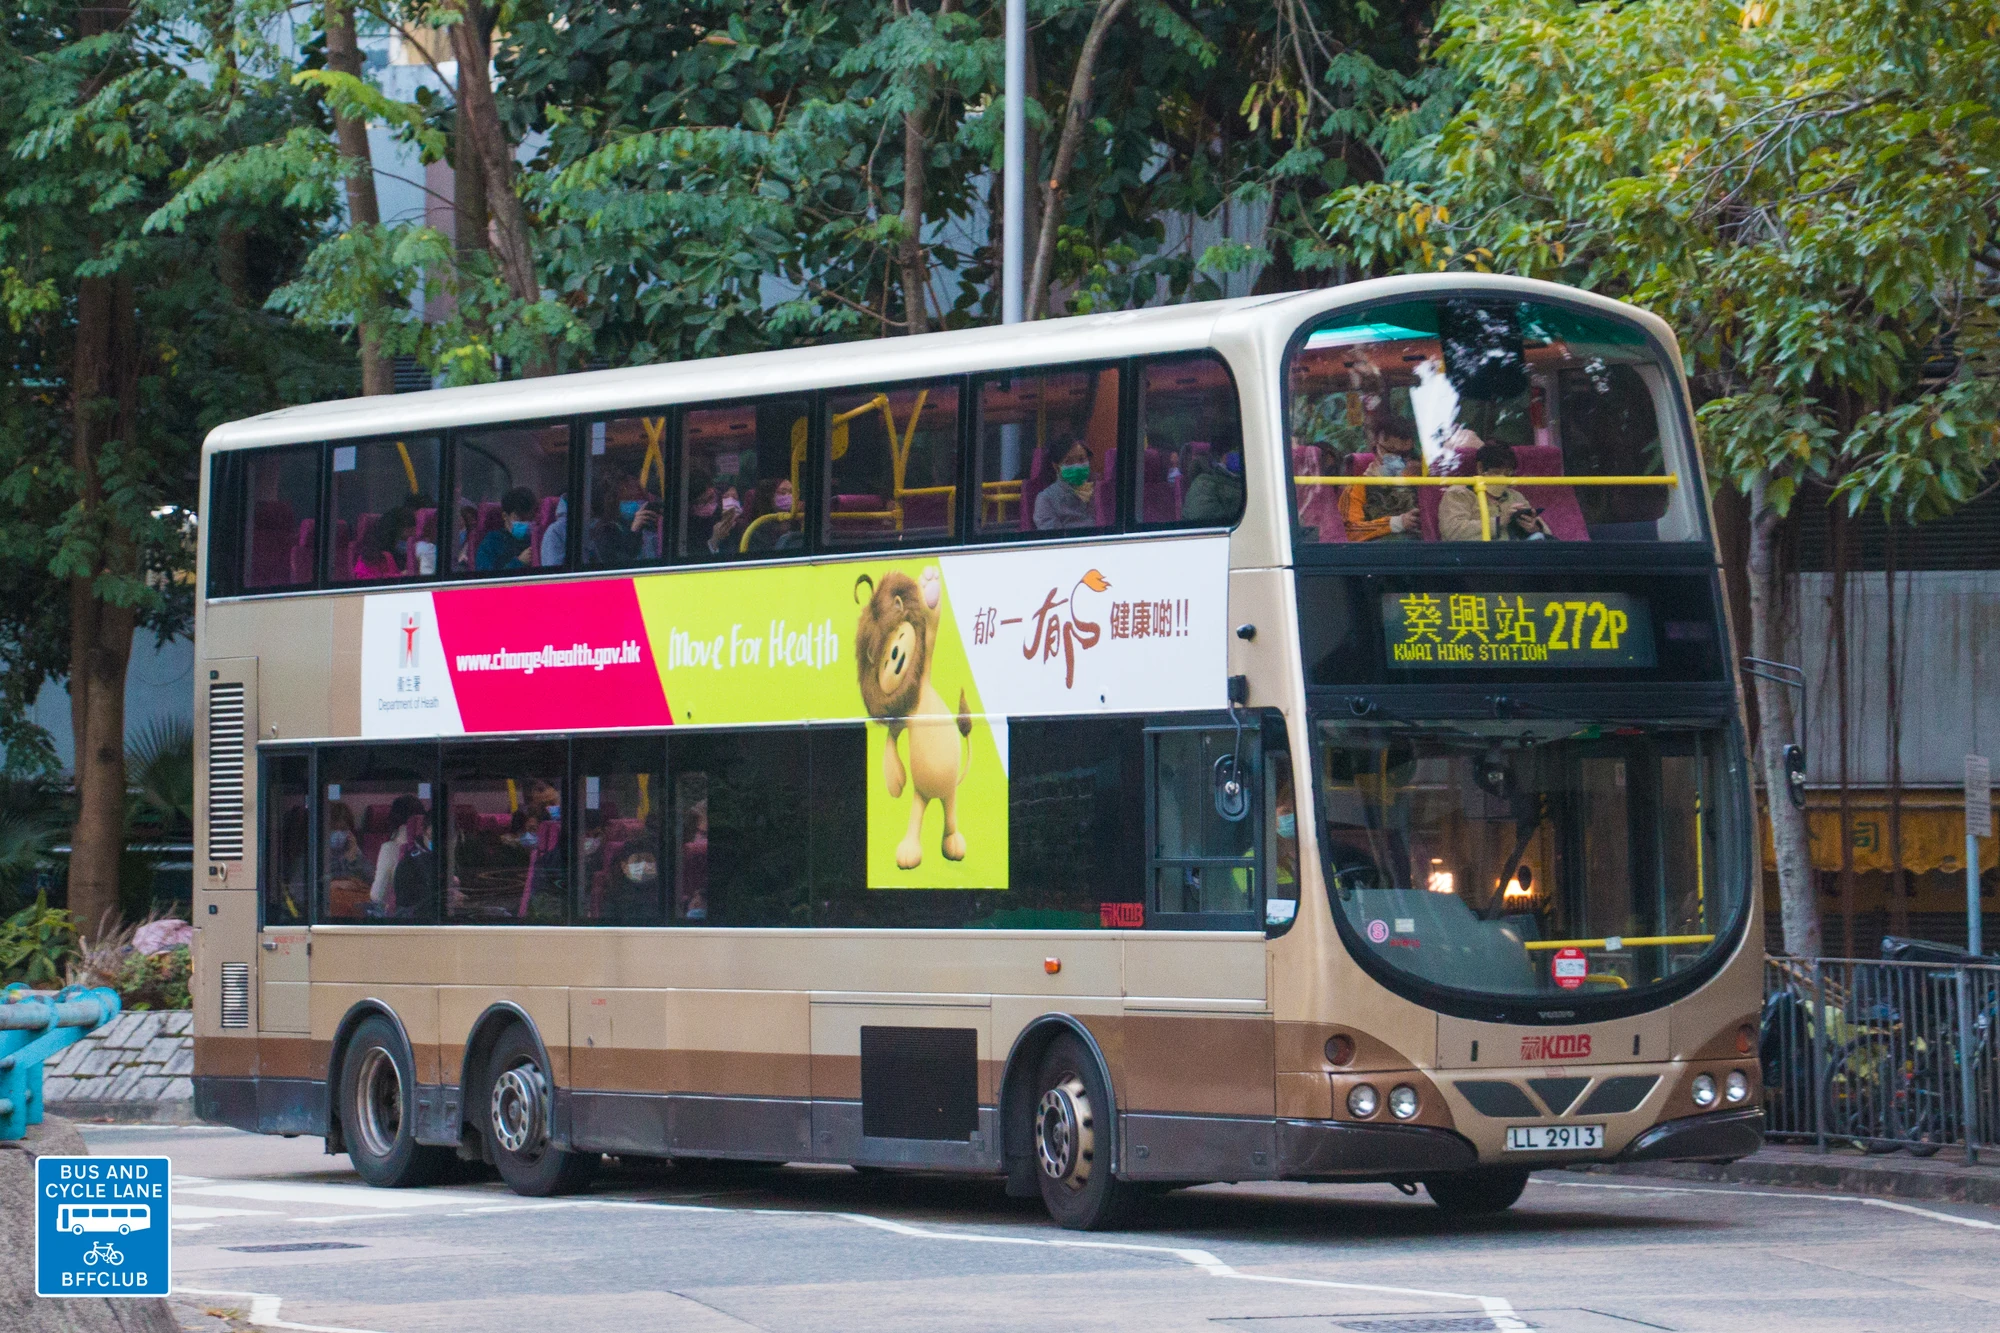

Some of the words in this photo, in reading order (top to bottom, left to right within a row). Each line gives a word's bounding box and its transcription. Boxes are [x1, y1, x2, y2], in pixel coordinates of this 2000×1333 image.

[1399, 593, 1537, 643] 葵興站
[1544, 601, 1628, 650] 272P
[456, 640, 641, 674] www.change4health.gov.hk
[668, 626, 725, 670] Move
[729, 623, 763, 668] For
[768, 618, 839, 671] Health
[1393, 643, 1433, 661] KWAI
[1438, 643, 1474, 661] HING
[1479, 643, 1548, 661] STATION
[378, 698, 413, 712] Department
[414, 696, 421, 709] of
[421, 695, 440, 709] Health
[1112, 902, 1145, 927] KMB
[1540, 1033, 1592, 1060] KMB
[1513, 1129, 1539, 1148] LL
[1545, 1127, 1597, 1147] 2913
